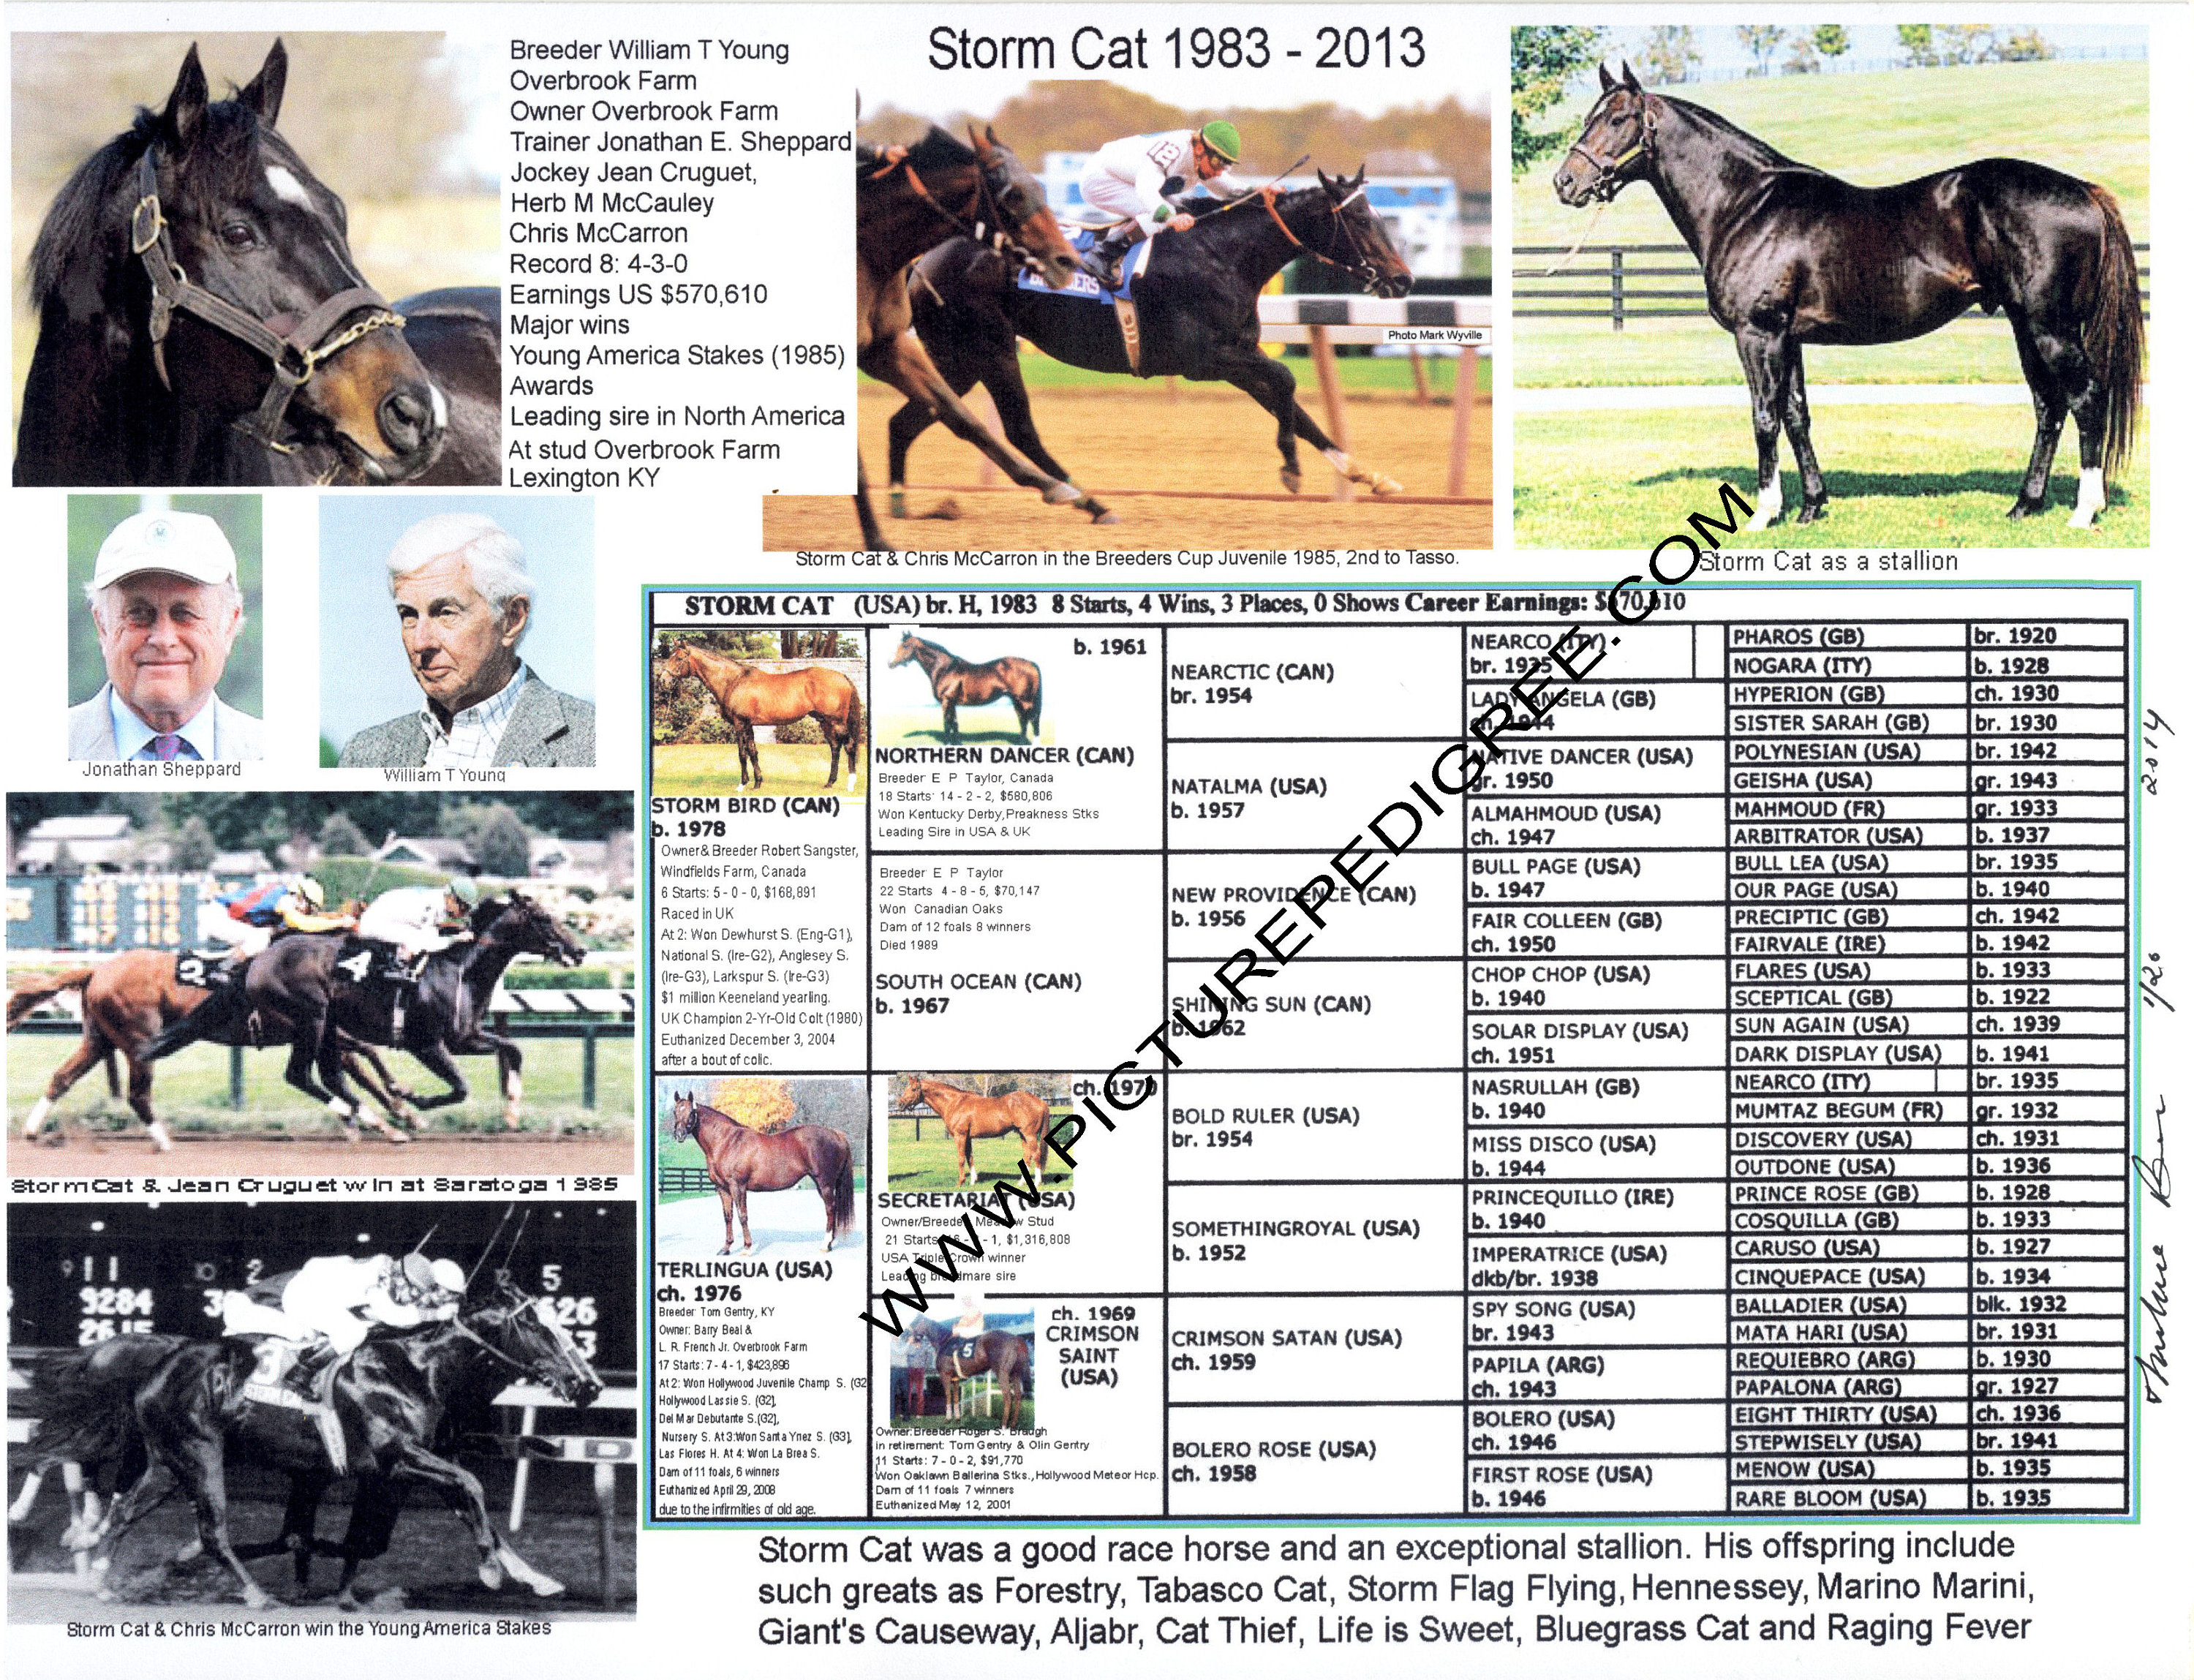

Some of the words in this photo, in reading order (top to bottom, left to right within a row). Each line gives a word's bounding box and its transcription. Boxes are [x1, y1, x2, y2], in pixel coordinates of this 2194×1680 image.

[511, 39, 603, 60] Breeder
[608, 39, 690, 60] William
[698, 39, 713, 59] T
[718, 39, 789, 65] Young
[929, 26, 1055, 70] Storm
[1071, 26, 1148, 70] Cat
[1165, 26, 1270, 69] 1983
[1316, 26, 1425, 68] 2013
[510, 131, 591, 152] Trainer
[597, 131, 702, 152] Jonathan
[711, 131, 732, 151] E.
[741, 130, 851, 157] Sheppard
[510, 284, 611, 309] Earnings
[619, 283, 653, 305] US
[661, 283, 767, 308] $570,610
[1389, 330, 1417, 340] Photo
[1420, 330, 1444, 340] Mark
[1446, 330, 1482, 342] Wyville
[511, 405, 601, 432] Leading
[609, 405, 649, 426] sire
[657, 405, 676, 426] in
[685, 405, 745, 426] North
[751, 405, 845, 426] America
[510, 467, 619, 493] Lexington
[628, 467, 660, 487] KY
[796, 550, 846, 567] Storm
[851, 550, 882, 567] Cat
[886, 550, 900, 567] &
[905, 550, 949, 566] Chris
[954, 550, 1037, 566] McCarron
[1044, 550, 1058, 566] in
[1063, 550, 1090, 566] the
[1096, 550, 1172, 566] Breeders
[1177, 549, 1213, 569] Cup
[1218, 549, 1287, 565] Juvenile
[1294, 549, 1340, 568] 1985,
[1346, 549, 1379, 565] 2nd
[1384, 549, 1401, 565] to
[1405, 549, 1459, 565] Tasso.
[1700, 551, 1764, 571] Storm
[1774, 551, 1812, 571] Cat
[1822, 555, 1847, 571] as
[1857, 555, 1869, 570] a
[1879, 549, 1958, 570] stallion
[685, 595, 776, 616] STORM
[782, 595, 834, 616] CAT
[854, 594, 921, 618] (USA)
[925, 594, 953, 614] br.
[958, 594, 982, 617] H,
[990, 593, 1037, 614] 1983
[1734, 628, 1813, 645] PHAROS
[1820, 627, 1865, 647] (GB)
[1974, 626, 2001, 644] br.
[2009, 626, 2057, 644] 1920
[1074, 638, 1092, 655] b.
[1100, 639, 1147, 656] 1961
[1171, 663, 1270, 680] NEARCTIC
[1276, 663, 1334, 684] (CAN)
[1170, 687, 1196, 704] br.
[1205, 687, 1253, 704] 1954
[875, 747, 982, 764] NORTHERN
[990, 747, 1071, 764] DANCER
[1077, 745, 1134, 767] (CAN)
[2141, 708, 2176, 796] 2014
[83, 761, 157, 777] Jonathan
[163, 761, 241, 779] Sheppard
[384, 768, 441, 782] William
[445, 768, 456, 781] T
[879, 772, 924, 783] Breeder
[932, 772, 940, 783] E
[949, 772, 957, 783] P
[965, 772, 1005, 785] Taylor,
[1010, 772, 1053, 783] Canada
[651, 797, 720, 814] STORM
[728, 797, 777, 813] BIRD
[783, 796, 840, 818] (CAN)
[1471, 805, 1598, 822] ALMAHMOUD
[1605, 804, 1662, 826] (USA)
[712, 844, 758, 856] Breeder
[761, 844, 801, 856] Robert
[804, 844, 859, 859] Sangster,
[660, 865, 720, 878] Windfields
[723, 865, 757, 879] Farm,
[761, 865, 806, 878] Canada
[179, 957, 206, 986] 2
[338, 951, 372, 982] 4
[875, 973, 943, 990] SOUTH
[950, 973, 1017, 990] OCEAN
[1025, 972, 1082, 993] (CAN)
[661, 1012, 679, 1025] UK
[683, 1012, 742, 1027] Champion
[745, 1012, 796, 1024] 2-Yr-Old
[799, 1012, 823, 1024] Colt
[826, 1012, 863, 1027] (1980)
[1472, 1079, 1588, 1096] NASRULLAH
[1595, 1077, 1640, 1099] (GB)
[1735, 1102, 1818, 1120] MUMTAZ
[1826, 1102, 1895, 1119] BEGUM
[1902, 1102, 1944, 1123] (FR)
[144, 1178, 161, 1194] &
[167, 1178, 230, 1194] Jean
[237, 1178, 338, 1196] Cruguet
[401, 1178, 426, 1194] at
[432, 1178, 548, 1196] Saratoga
[557, 1178, 618, 1194] 1985
[1172, 1220, 1356, 1238] SOMETHINGROYAL
[1362, 1218, 1420, 1240] (USA)
[541, 1264, 562, 1292] 5
[657, 1261, 769, 1278] TERLINGUA
[775, 1259, 833, 1282] (USA)
[656, 1284, 685, 1303] ch.
[694, 1284, 742, 1302] 1976
[1046, 1325, 1139, 1343] CRIMSON
[1172, 1330, 1264, 1347] CRIMSON
[1273, 1329, 1338, 1346] SATAN
[1345, 1327, 1403, 1350] (USA)
[962, 1342, 974, 1358] 5
[252, 1338, 281, 1385] 3
[1472, 1357, 1540, 1374] PAPILA
[1547, 1355, 1605, 1377] (ARG)
[1735, 1491, 1786, 1507] RARE
[1794, 1489, 1862, 1507] BLOOM
[1869, 1488, 1926, 1509] (USA)
[1976, 1489, 1994, 1507] b.
[2002, 1488, 2051, 1507] 1935
[758, 1536, 848, 1563] Storm
[859, 1535, 912, 1563] Cat
[922, 1541, 984, 1562] was
[994, 1542, 1012, 1562] a
[1022, 1534, 1096, 1569] good
[1108, 1541, 1173, 1562] race
[1185, 1534, 1270, 1562] horse
[1281, 1534, 1336, 1562] and
[1348, 1540, 1384, 1561] an
[1396, 1532, 1566, 1567] exceptional
[1577, 1532, 1691, 1559] stallion.
[1705, 1532, 1753, 1559] His
[1763, 1531, 1894, 1565] offspring
[1907, 1530, 2015, 1558] include
[67, 1621, 115, 1638] Storm
[121, 1621, 150, 1638] Cat
[154, 1620, 167, 1637] &
[170, 1621, 216, 1637] Chris
[222, 1621, 300, 1637] McCarron
[305, 1621, 333, 1636] win
[338, 1620, 364, 1636] the
[368, 1620, 420, 1639] Young
[423, 1619, 491, 1636] America
[497, 1618, 552, 1635] Stakes
